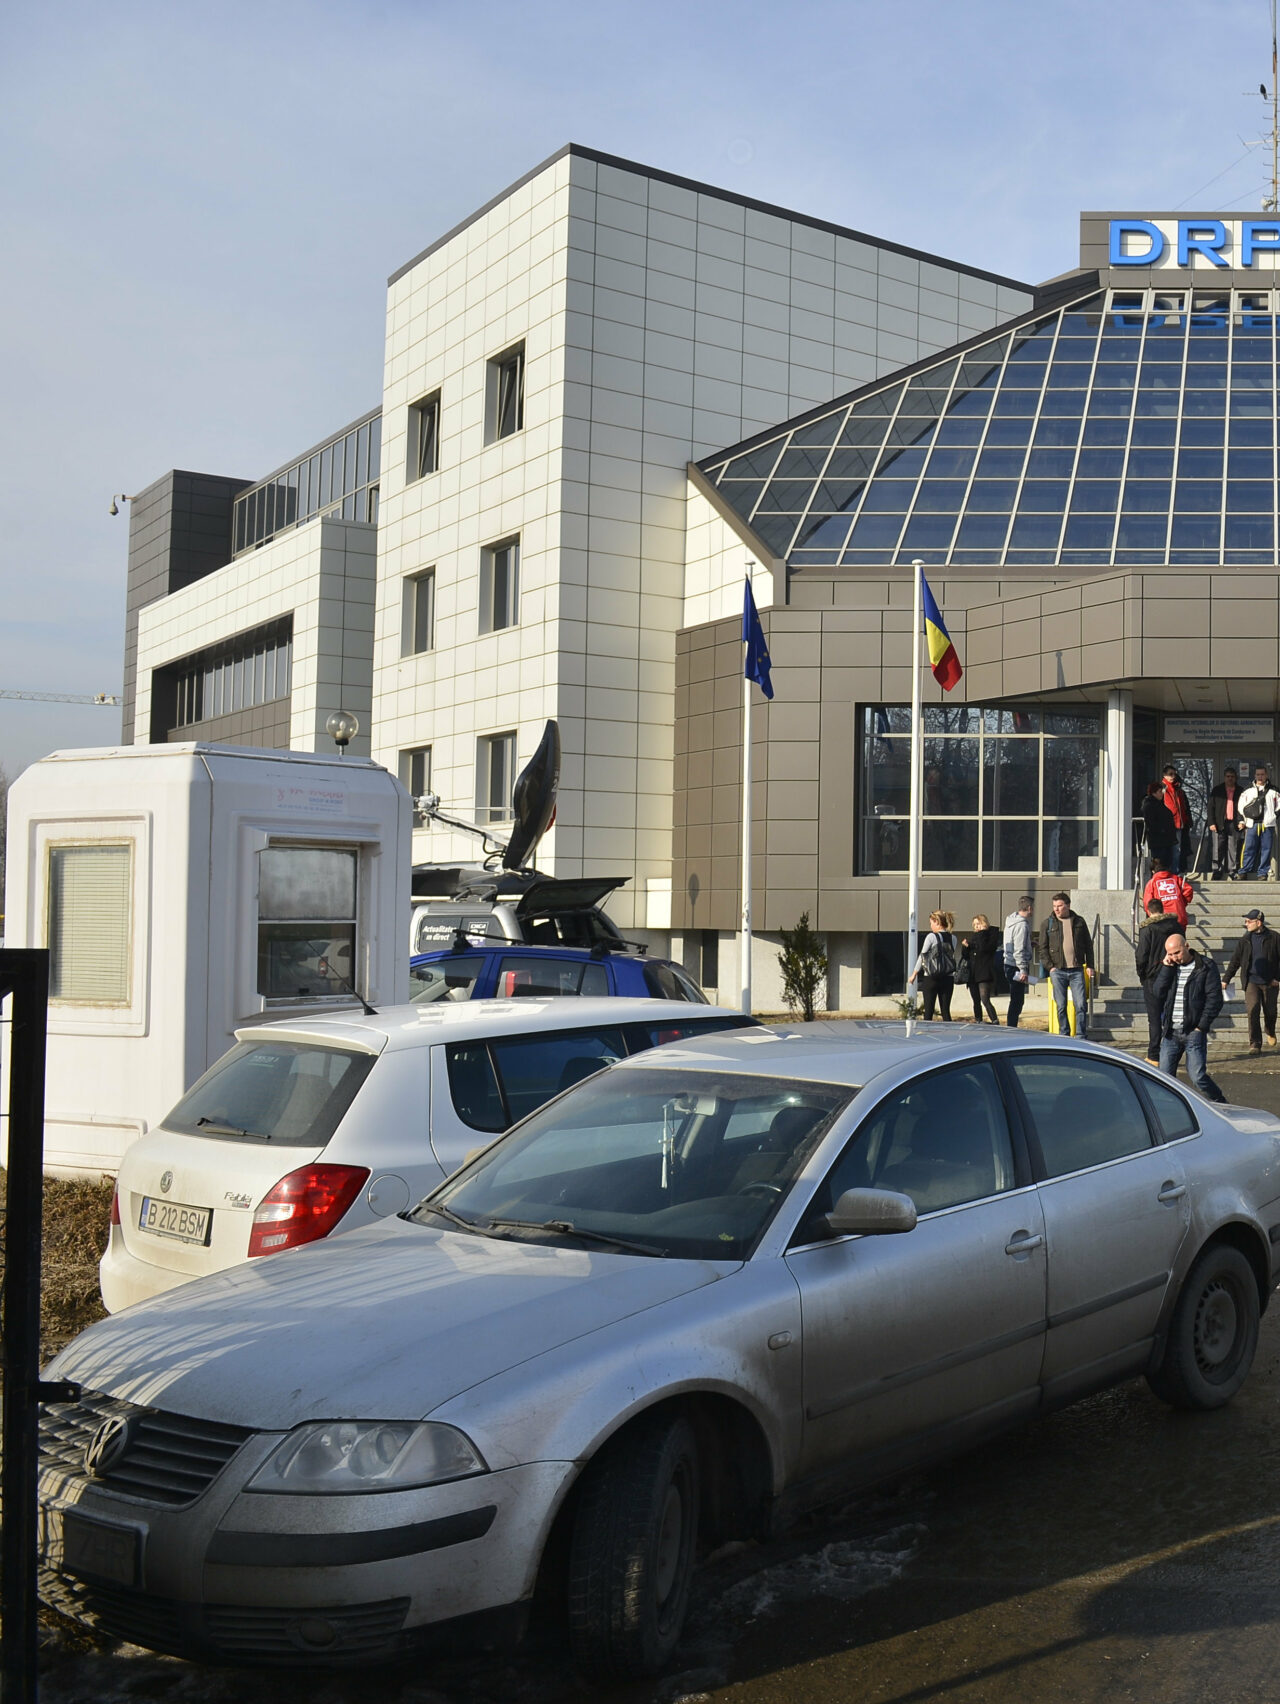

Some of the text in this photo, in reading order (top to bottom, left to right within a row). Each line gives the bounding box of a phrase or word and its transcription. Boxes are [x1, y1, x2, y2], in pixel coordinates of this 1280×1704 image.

[148, 1203, 206, 1238] B 212 BSM
